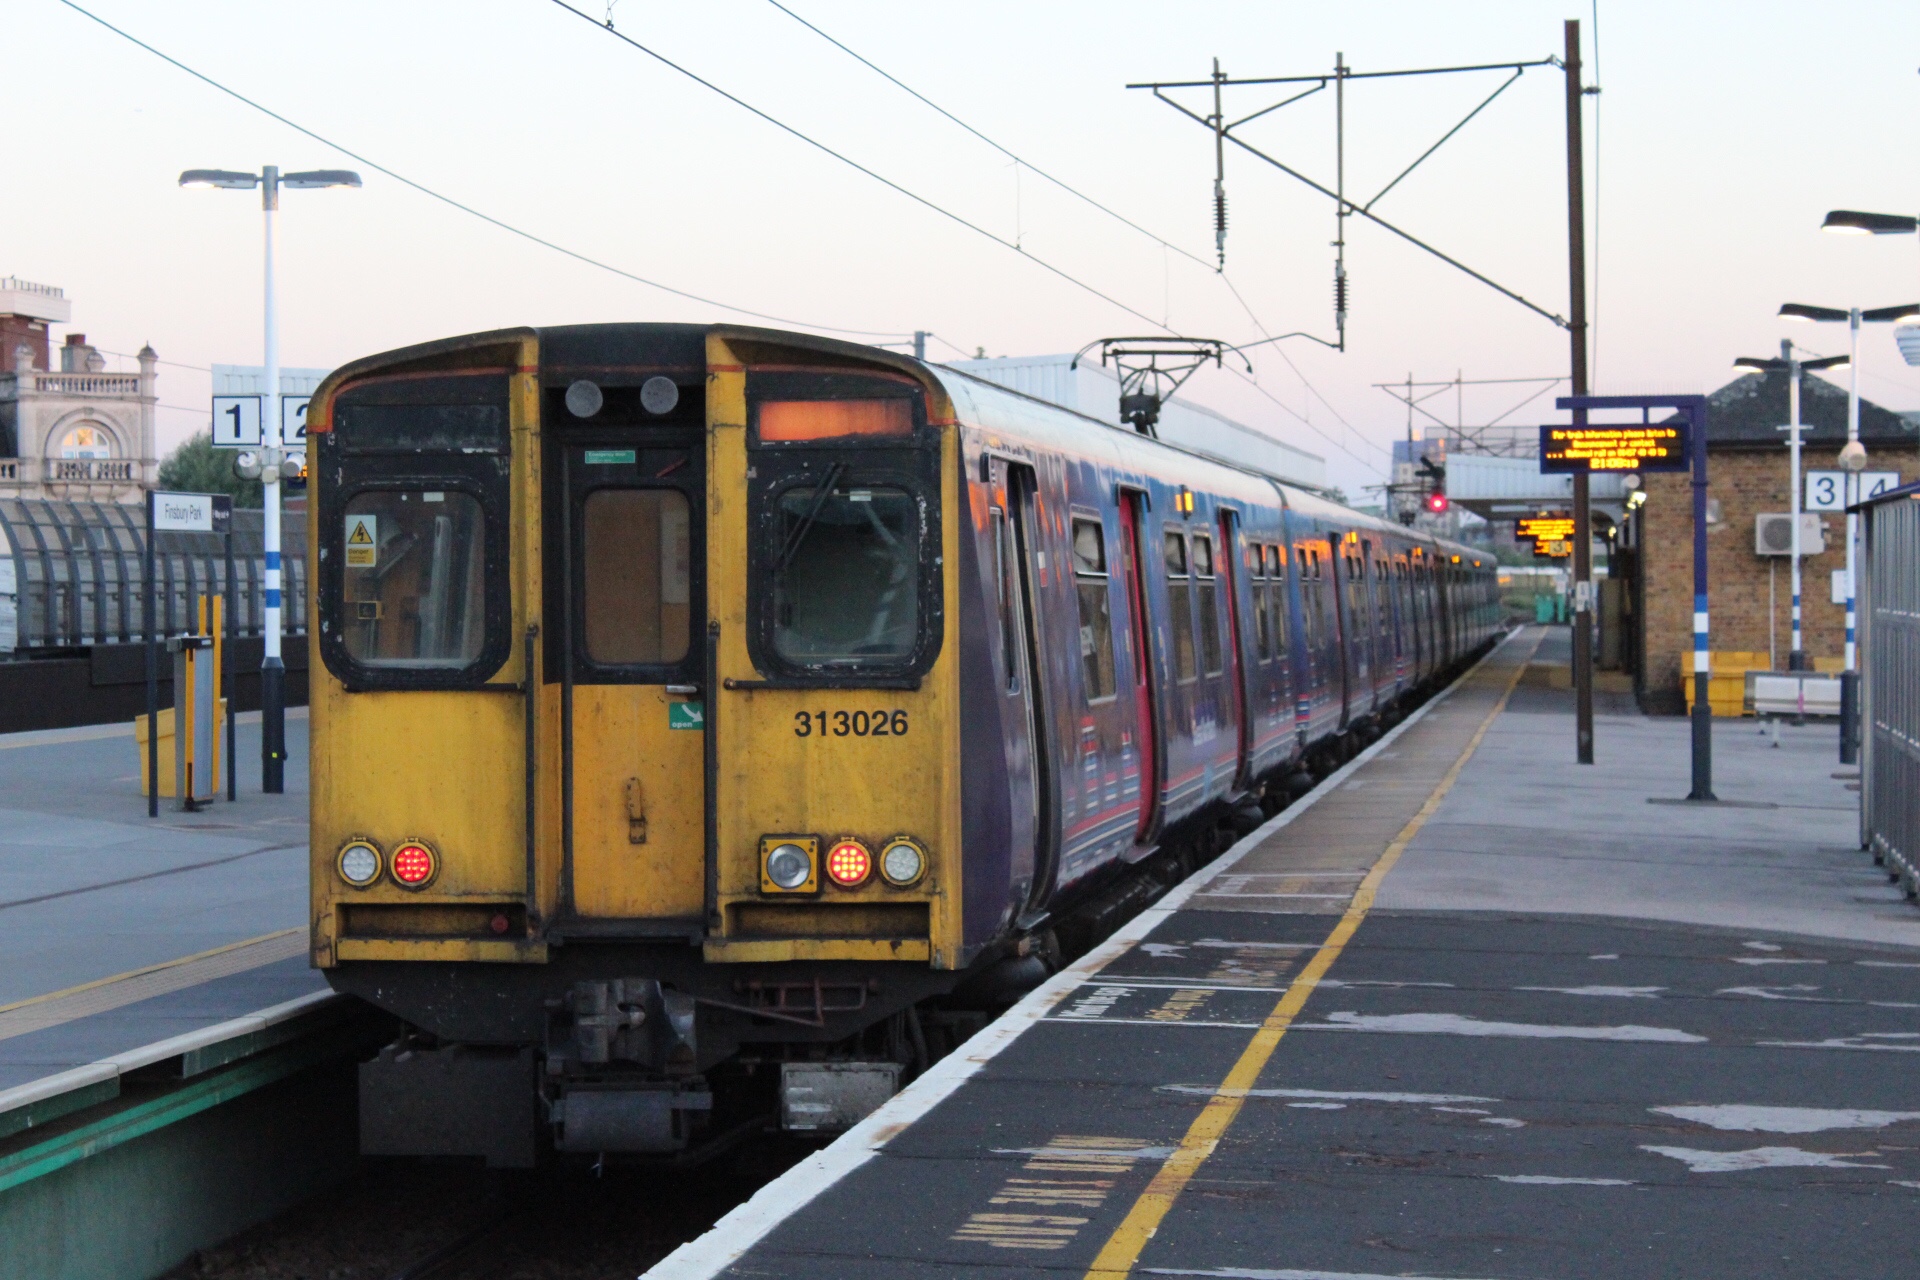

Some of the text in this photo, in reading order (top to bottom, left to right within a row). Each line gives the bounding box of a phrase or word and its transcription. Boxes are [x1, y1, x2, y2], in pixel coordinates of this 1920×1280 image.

[226, 403, 241, 438] 1
[1816, 476, 1836, 506] 3
[164, 503, 203, 524] Finsbury Park
[671, 721, 693, 729] open
[794, 709, 908, 737] 313026
